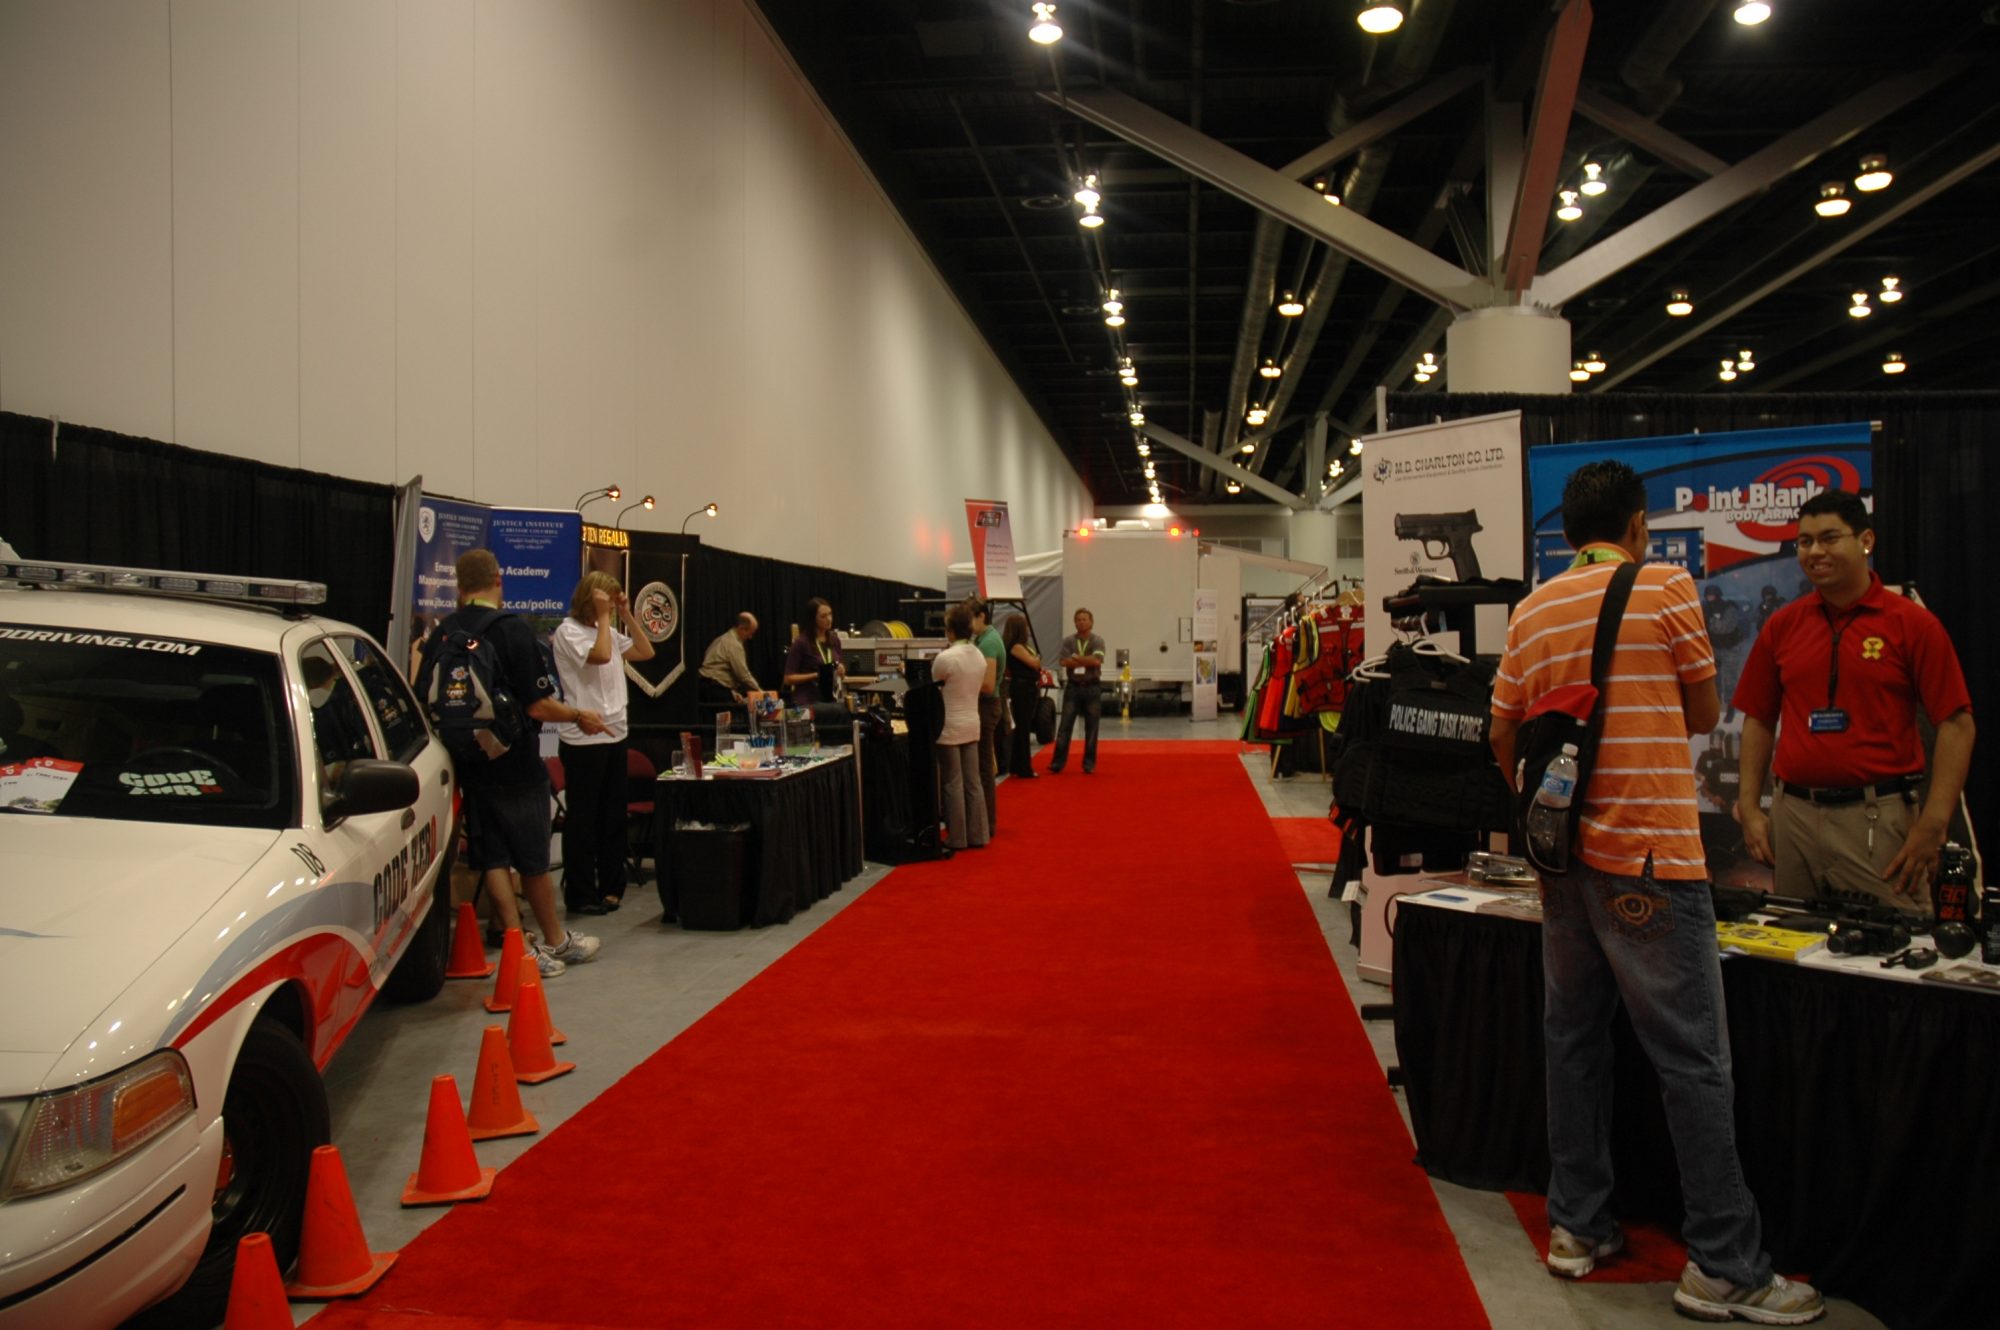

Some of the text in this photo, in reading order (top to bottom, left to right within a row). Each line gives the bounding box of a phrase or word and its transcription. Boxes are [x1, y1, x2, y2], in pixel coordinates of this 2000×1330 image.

[1395, 447, 1505, 475] M.D. CHARLTON CO. LTD.
[1675, 480, 1825, 513] Point Blank
[493, 519, 564, 529] JUSTICE INSTITUTE
[1726, 509, 1760, 523] BODY
[598, 528, 628, 547] REGALIA
[506, 565, 550, 578] Academy
[1389, 704, 1483, 742] POLICE GANG TASK FORCE
[118, 769, 217, 787] CODE
[373, 846, 409, 935] CODE
